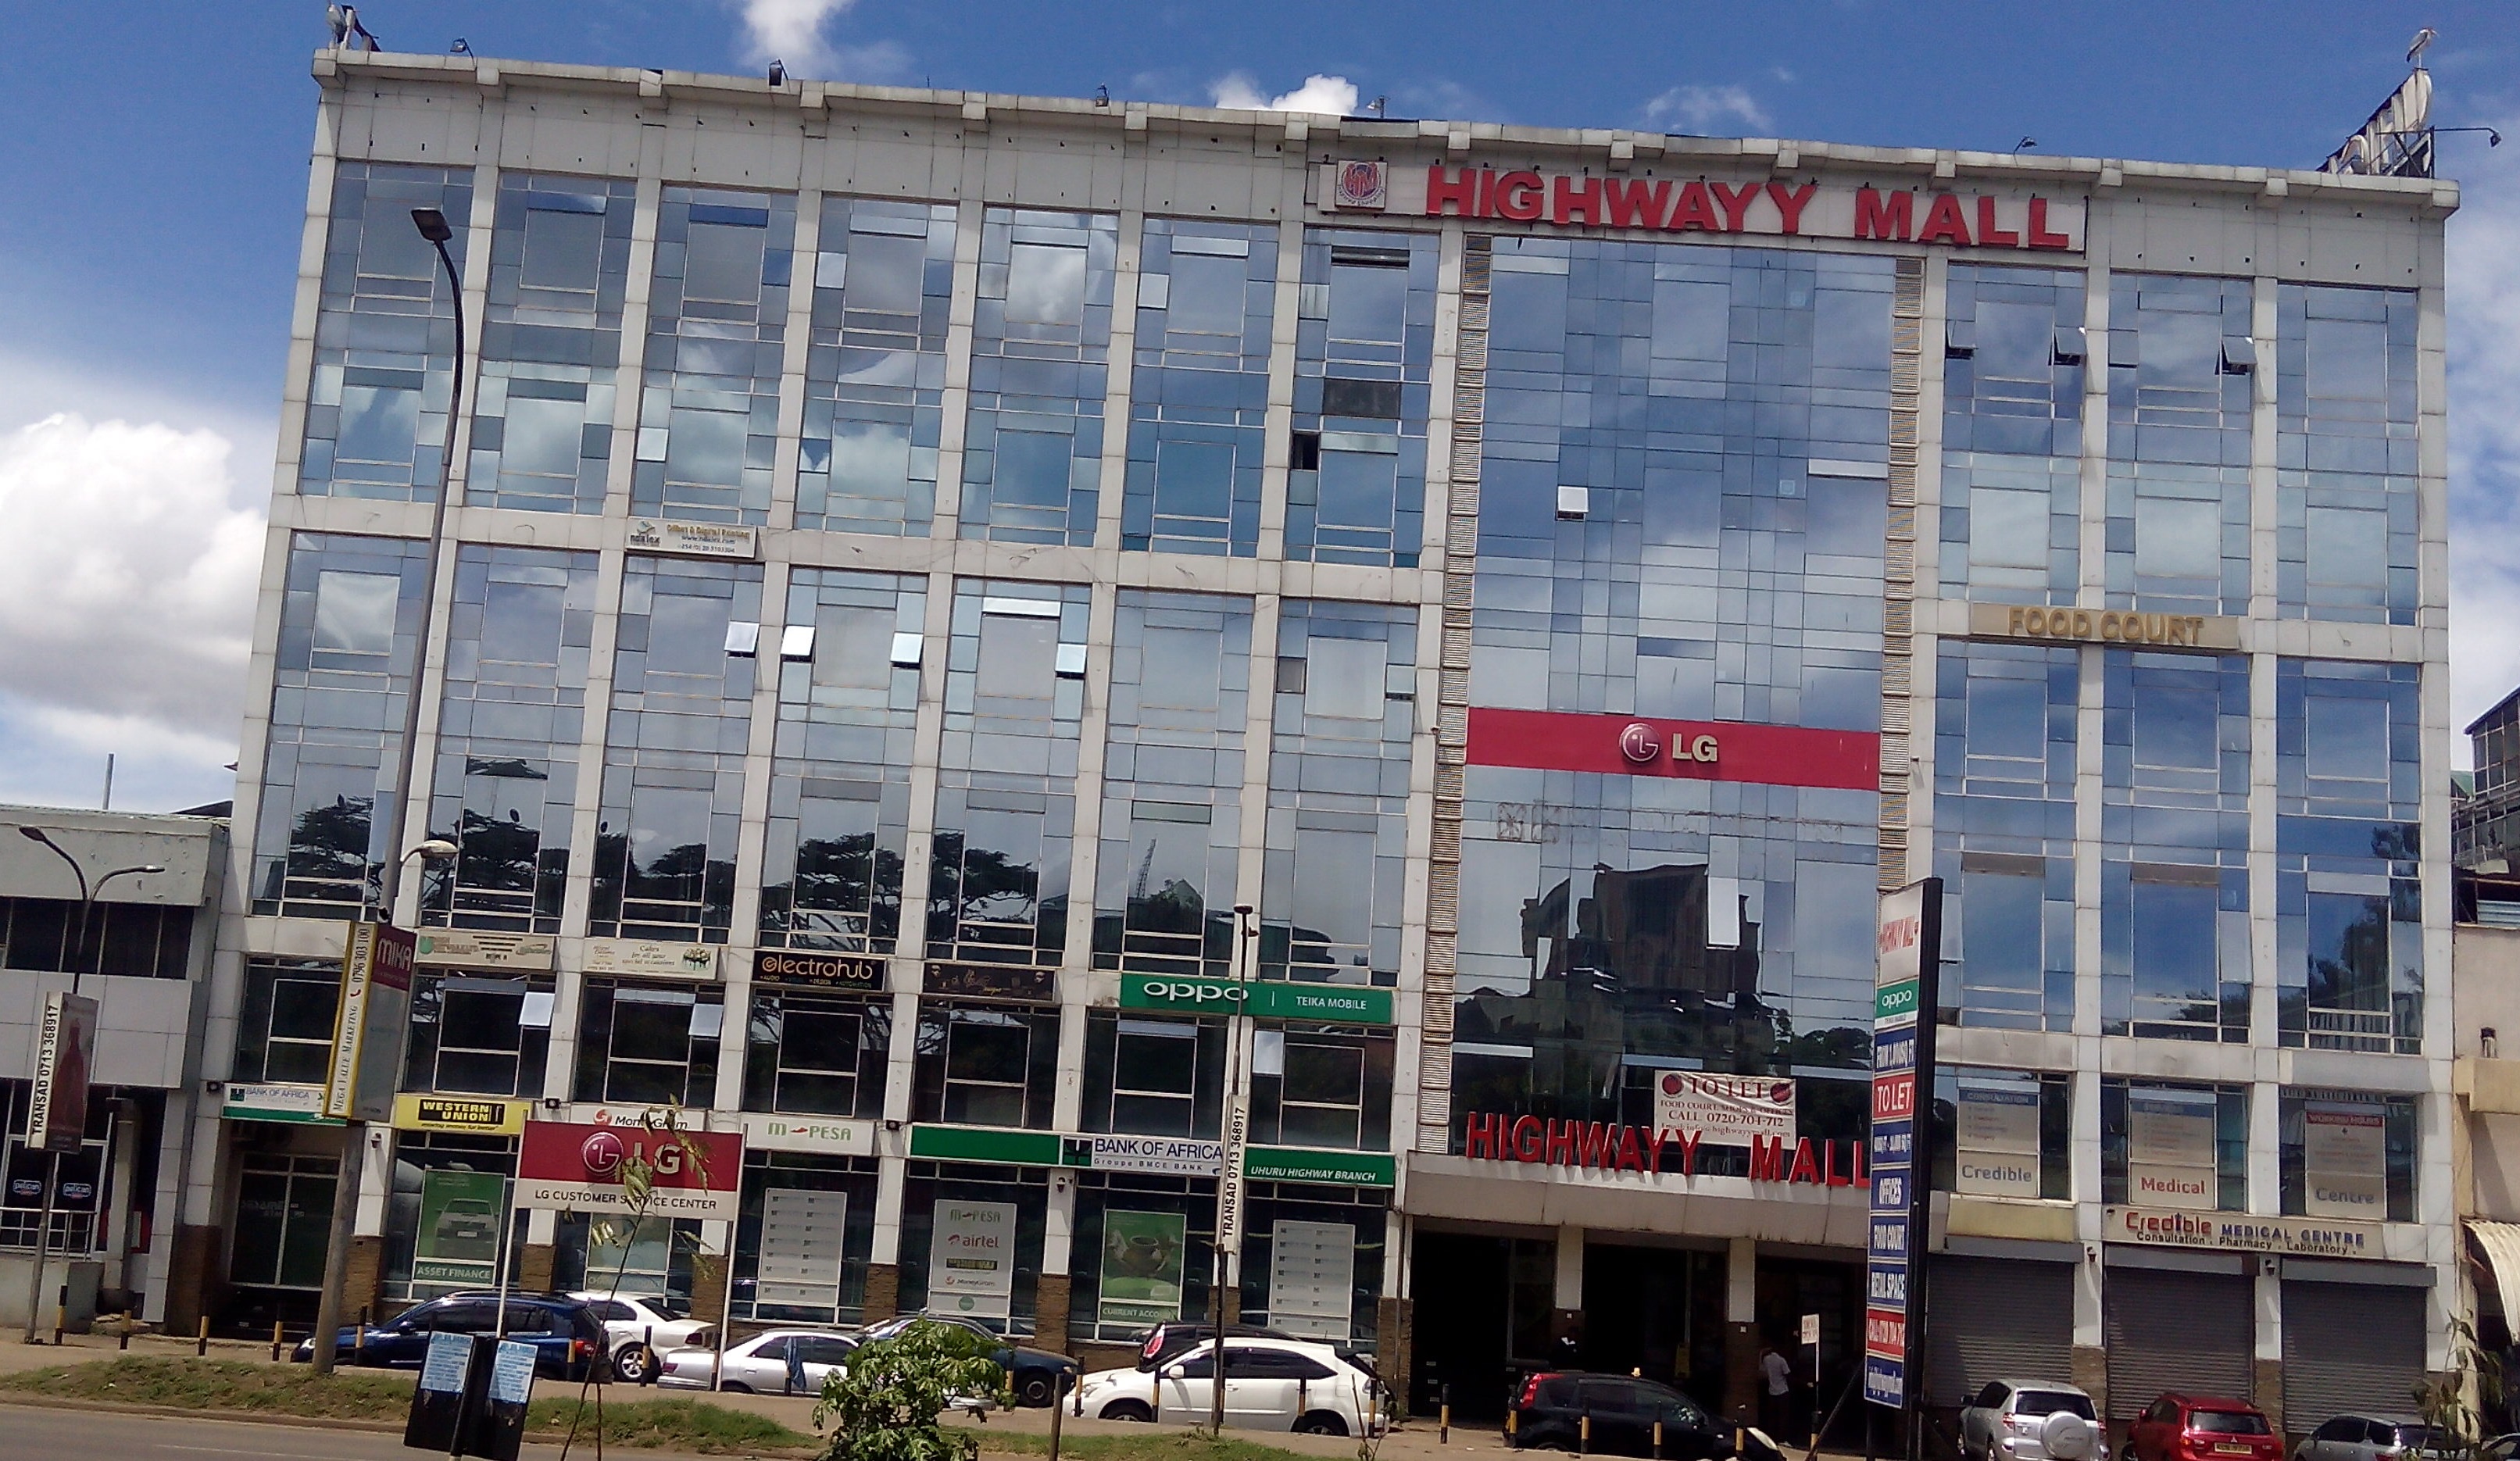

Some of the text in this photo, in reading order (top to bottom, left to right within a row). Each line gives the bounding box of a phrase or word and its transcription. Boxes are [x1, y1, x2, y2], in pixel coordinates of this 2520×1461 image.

[1427, 166, 2070, 248] HIGHWAYY MALL
[2008, 606, 2204, 645] FOOD COURT
[1671, 733, 1718, 763] LG
[357, 928, 370, 943] 100
[356, 946, 368, 961] 303
[352, 962, 365, 983] 0796
[762, 954, 873, 980] electrohub
[1143, 981, 1249, 1003] oppo
[1882, 989, 1913, 1009] oppo
[1296, 995, 1367, 1011] TEIKA MOBILE
[32, 1005, 59, 1134] TRANSAD 0713 368917
[246, 1088, 267, 1096] BANK
[1689, 1077, 1767, 1098] TO LET
[1877, 1081, 1912, 1113] TO LET
[423, 1101, 490, 1113] WESTERN
[441, 1111, 490, 1122] UNION
[1668, 1110, 1701, 1121] CALL
[633, 1141, 683, 1174] LG
[1095, 1138, 1224, 1160] BANK OF AFRICA
[1465, 1111, 1870, 1188] HIGHWAYY MALL
[1174, 1163, 1203, 1171] BANK
[1223, 1106, 1246, 1238] TRANSAD 0713 368917
[1250, 1166, 1376, 1181] UHURU HIGHWAY BRANCH
[1962, 1164, 2032, 1182] Credible
[2141, 1177, 2205, 1195] Medical
[534, 1190, 549, 1199] LG
[553, 1191, 617, 1203] CUSTOMER
[671, 1195, 717, 1209] CENTER
[2316, 1188, 2375, 1204] Centre
[2125, 1211, 2365, 1247] Credible MEDICAL CENTRE
[962, 1235, 999, 1248] airtel
[2136, 1231, 2348, 1256] Consultation Pharmacy Laboratory
[416, 1267, 491, 1279] ASSET FINANCE
[1103, 1307, 1138, 1316] CURRENT
